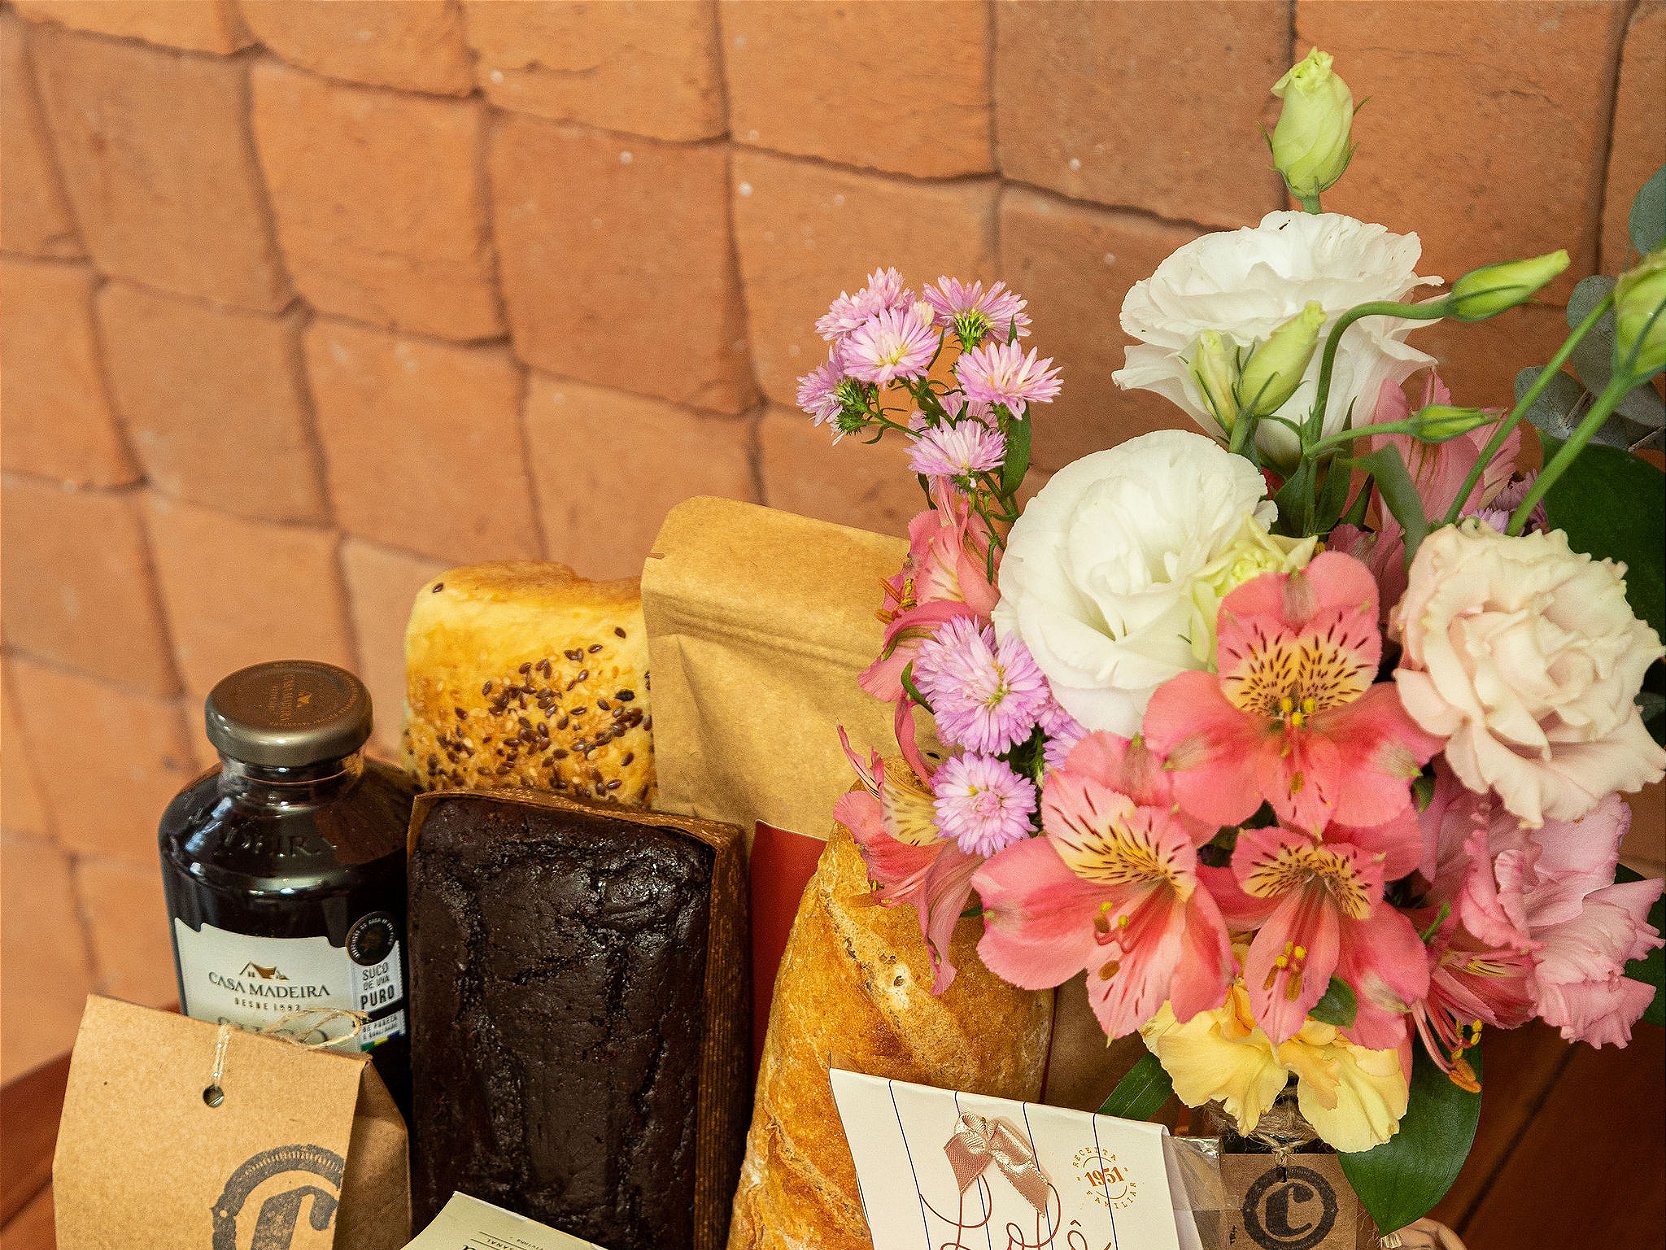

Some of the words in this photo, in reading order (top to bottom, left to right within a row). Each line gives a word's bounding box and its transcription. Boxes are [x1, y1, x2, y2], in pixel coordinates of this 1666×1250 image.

[362, 962, 389, 981] SUCO
[208, 971, 246, 994] CASA
[249, 982, 331, 999] MADEIRA
[360, 985, 395, 1010] PURO
[1084, 1166, 1125, 1187] 1951
